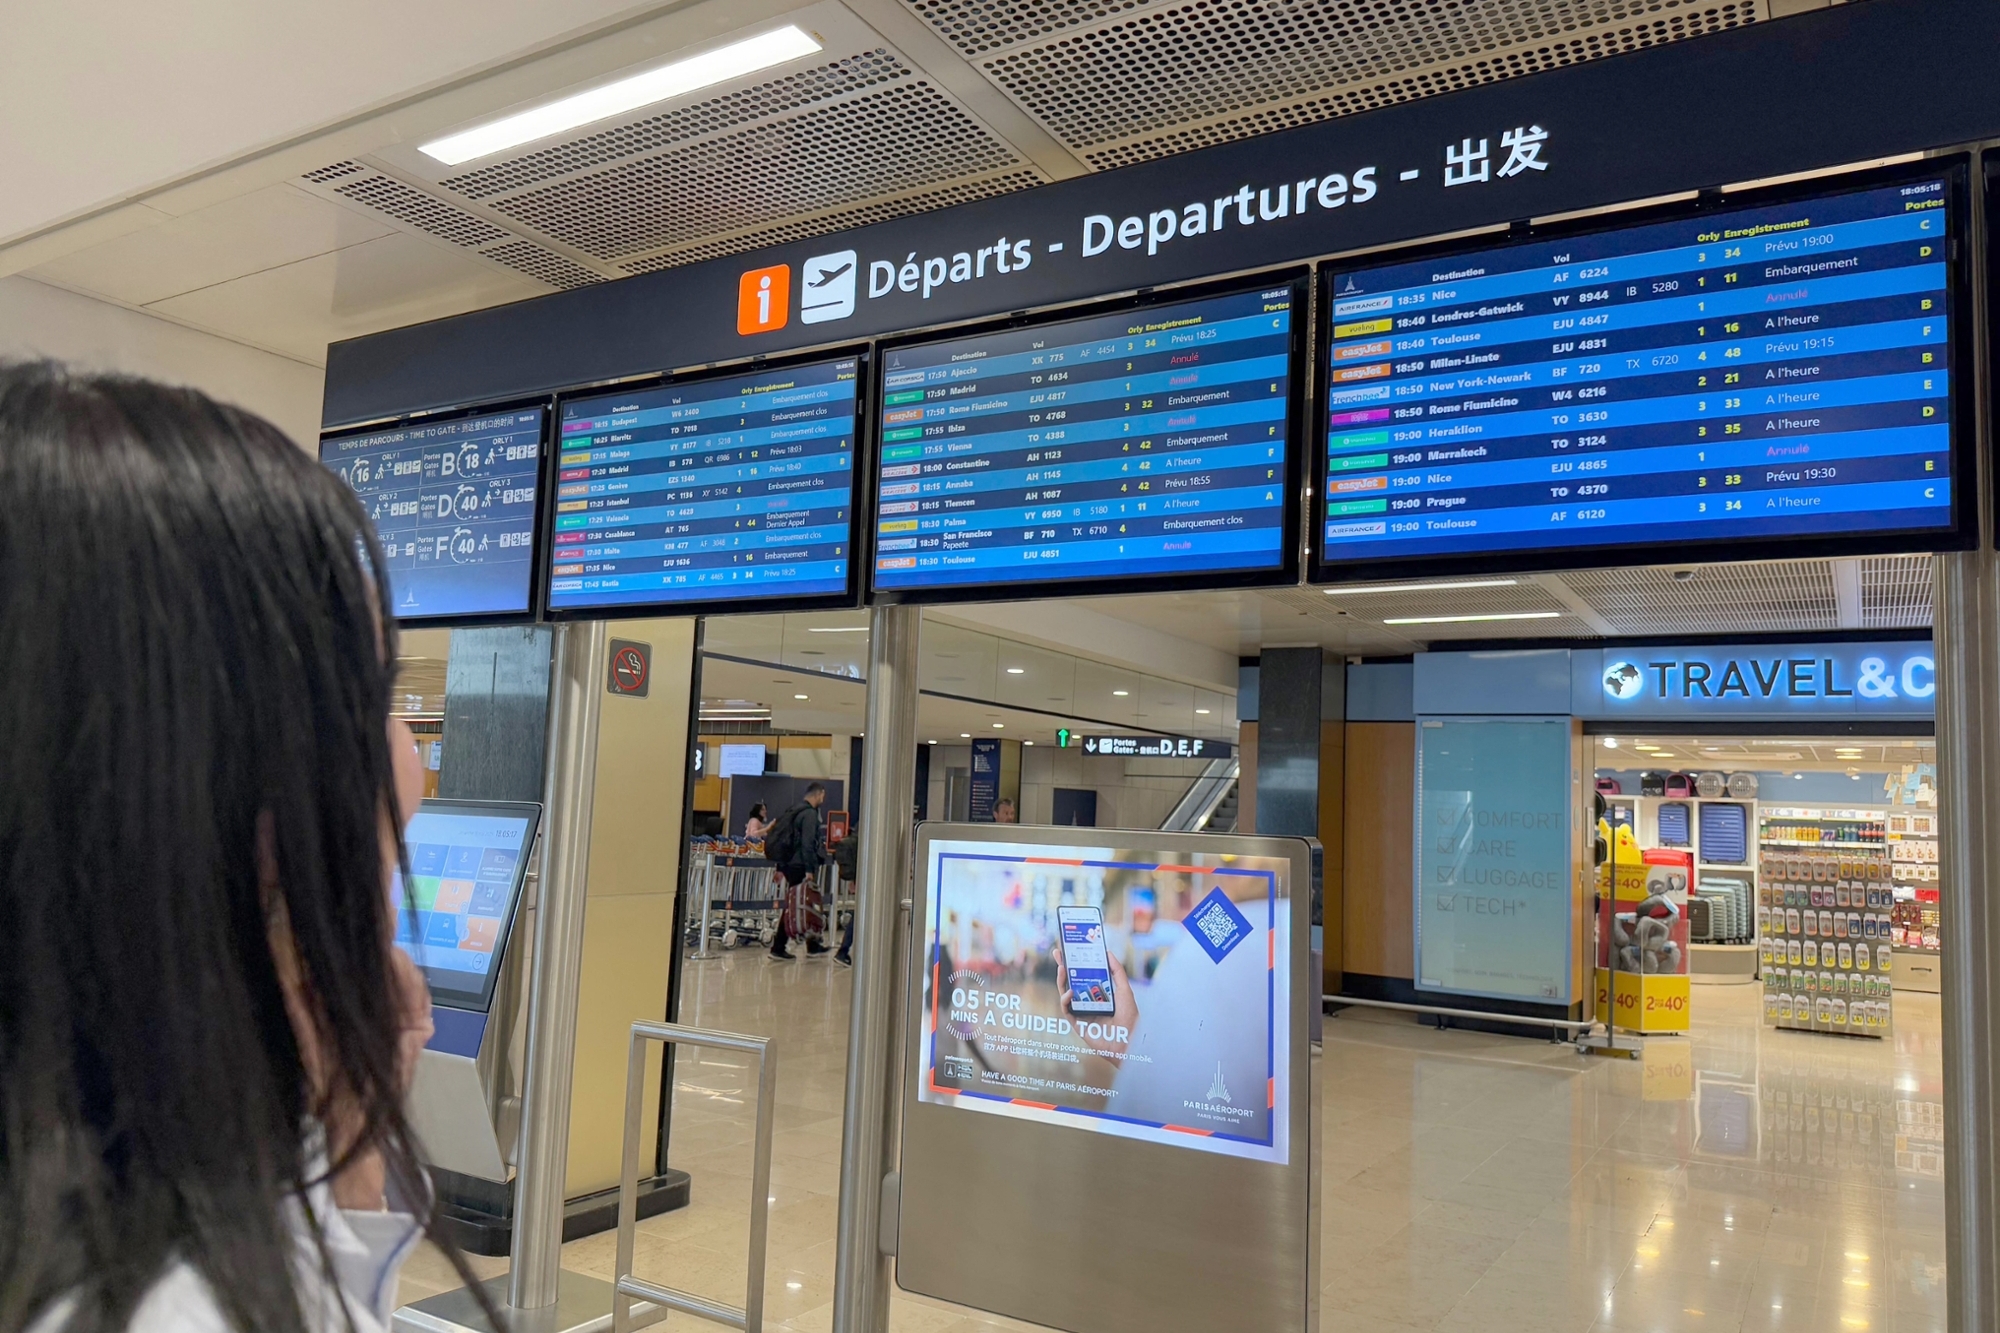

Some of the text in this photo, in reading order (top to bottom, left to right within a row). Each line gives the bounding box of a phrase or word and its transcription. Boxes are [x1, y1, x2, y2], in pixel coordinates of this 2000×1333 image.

[1444, 124, 1549, 189] 出发
[1900, 183, 1942, 196] 18:05:18
[869, 236, 1031, 299] Départs
[1082, 161, 1377, 257] Departures
[1432, 198, 1945, 282] Destination Vol Orly Enregistrement Portes
[1396, 256, 1858, 329] 18:40 Londres-Gatwick VY 8944 Embarquement
[1397, 266, 1609, 306] 18:35 Nice AF 6224
[1145, 316, 1202, 332] Enregistrement
[1396, 338, 1425, 351] 18:40
[1430, 333, 1481, 346] Toulouse
[1553, 318, 1574, 330] EJU
[1578, 314, 1609, 327] 4847
[1394, 336, 1835, 396] 18:50 New York-Newark BF 720 Prévu 19:15
[1395, 338, 1607, 374] 18:50 Milan-Linate EJU 4831
[928, 366, 978, 380] 17:50 Ajaccio
[926, 388, 946, 399] 17:50
[949, 384, 977, 395] Madrid
[1393, 386, 1607, 419] 18:50 Rome Fiumicino W4 6216
[771, 409, 815, 422] Embarquement
[815, 407, 828, 416] clos
[949, 400, 1009, 414] Rome Fiumicino
[948, 424, 966, 433] Ibiza
[1393, 410, 1608, 442] 19:00 Heraklion TO 3630
[339, 425, 455, 450] TEMPS DE PARCOURS TIME TO GATE
[947, 443, 973, 452] Vienna
[424, 453, 440, 461] Portes
[1392, 435, 1607, 464] 19:00 Marrakech TO 3124
[357, 467, 369, 482] 16
[441, 452, 455, 475] B
[465, 453, 479, 469] 18
[608, 465, 629, 474] Madrid
[923, 458, 990, 473] 18:00 Constantine
[1392, 459, 1608, 487] 19:00 Nice EJU 4865
[922, 479, 974, 492] 18:15 Annaba
[944, 475, 1211, 508] Tlemcen Prévu 18:55
[437, 494, 478, 517] D 40
[1391, 484, 1609, 510] 19:00 Prague TO 4370
[920, 518, 967, 529] 18:30 Palma
[1163, 515, 1243, 530] Embarquement clos
[1390, 509, 1606, 533] 19:00 Toulouse AF 6120
[604, 530, 636, 539] Casablanca
[942, 540, 970, 551] Papeete
[943, 529, 993, 541] San Francisco
[435, 536, 475, 559] F 40
[942, 555, 976, 565] Toulouse
[1113, 746, 1134, 754] Gates
[1160, 740, 1203, 757] D,E,F
[1463, 868, 1558, 889] LUGGAGE
[952, 987, 1021, 1011] 05 FOR
[951, 1010, 1129, 1044] MINS A GUIDED TOUR
[983, 1042, 996, 1051] 官方
[997, 1044, 1008, 1052] APP
[984, 1033, 997, 1042] Tout
[1027, 1038, 1042, 1047] dans
[1043, 1040, 1059, 1050] votre
[1060, 1044, 1079, 1054] poche
[1097, 1049, 1114, 1058] notre
[1115, 1052, 1128, 1062] app
[981, 1070, 999, 1080] HAVE
[1007, 1074, 1028, 1084] GOOD
[1029, 1077, 1045, 1087] TIME
[1046, 1080, 1055, 1088] AT
[1056, 1081, 1076, 1092] PARIS
